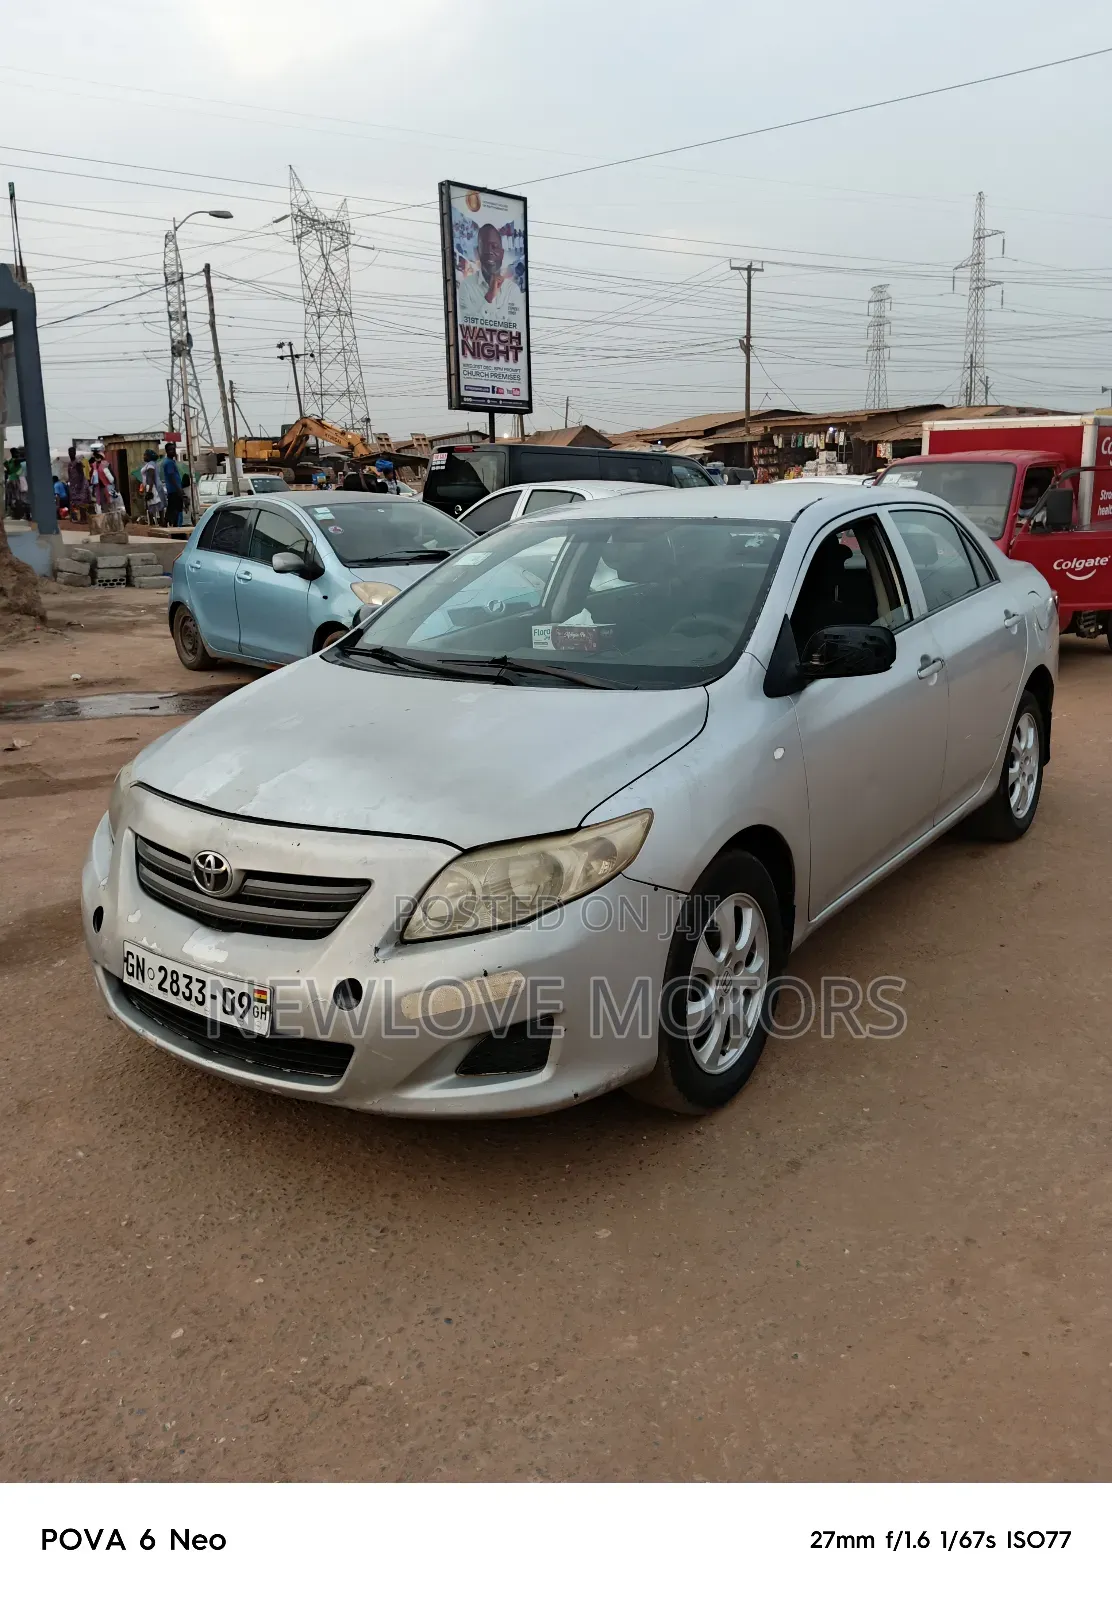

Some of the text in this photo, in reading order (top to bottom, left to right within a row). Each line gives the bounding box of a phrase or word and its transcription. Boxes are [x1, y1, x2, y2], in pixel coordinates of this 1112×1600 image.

[464, 316, 518, 329] 31ST DECEMBER
[459, 324, 522, 346] WATCH
[461, 339, 523, 363] NIGHT
[463, 370, 490, 378] CHURCH
[490, 373, 521, 381] PREMISES
[1053, 556, 1109, 571] Colgate
[533, 628, 550, 637] Flora
[125, 950, 268, 1021] GN 2833-09 GH
